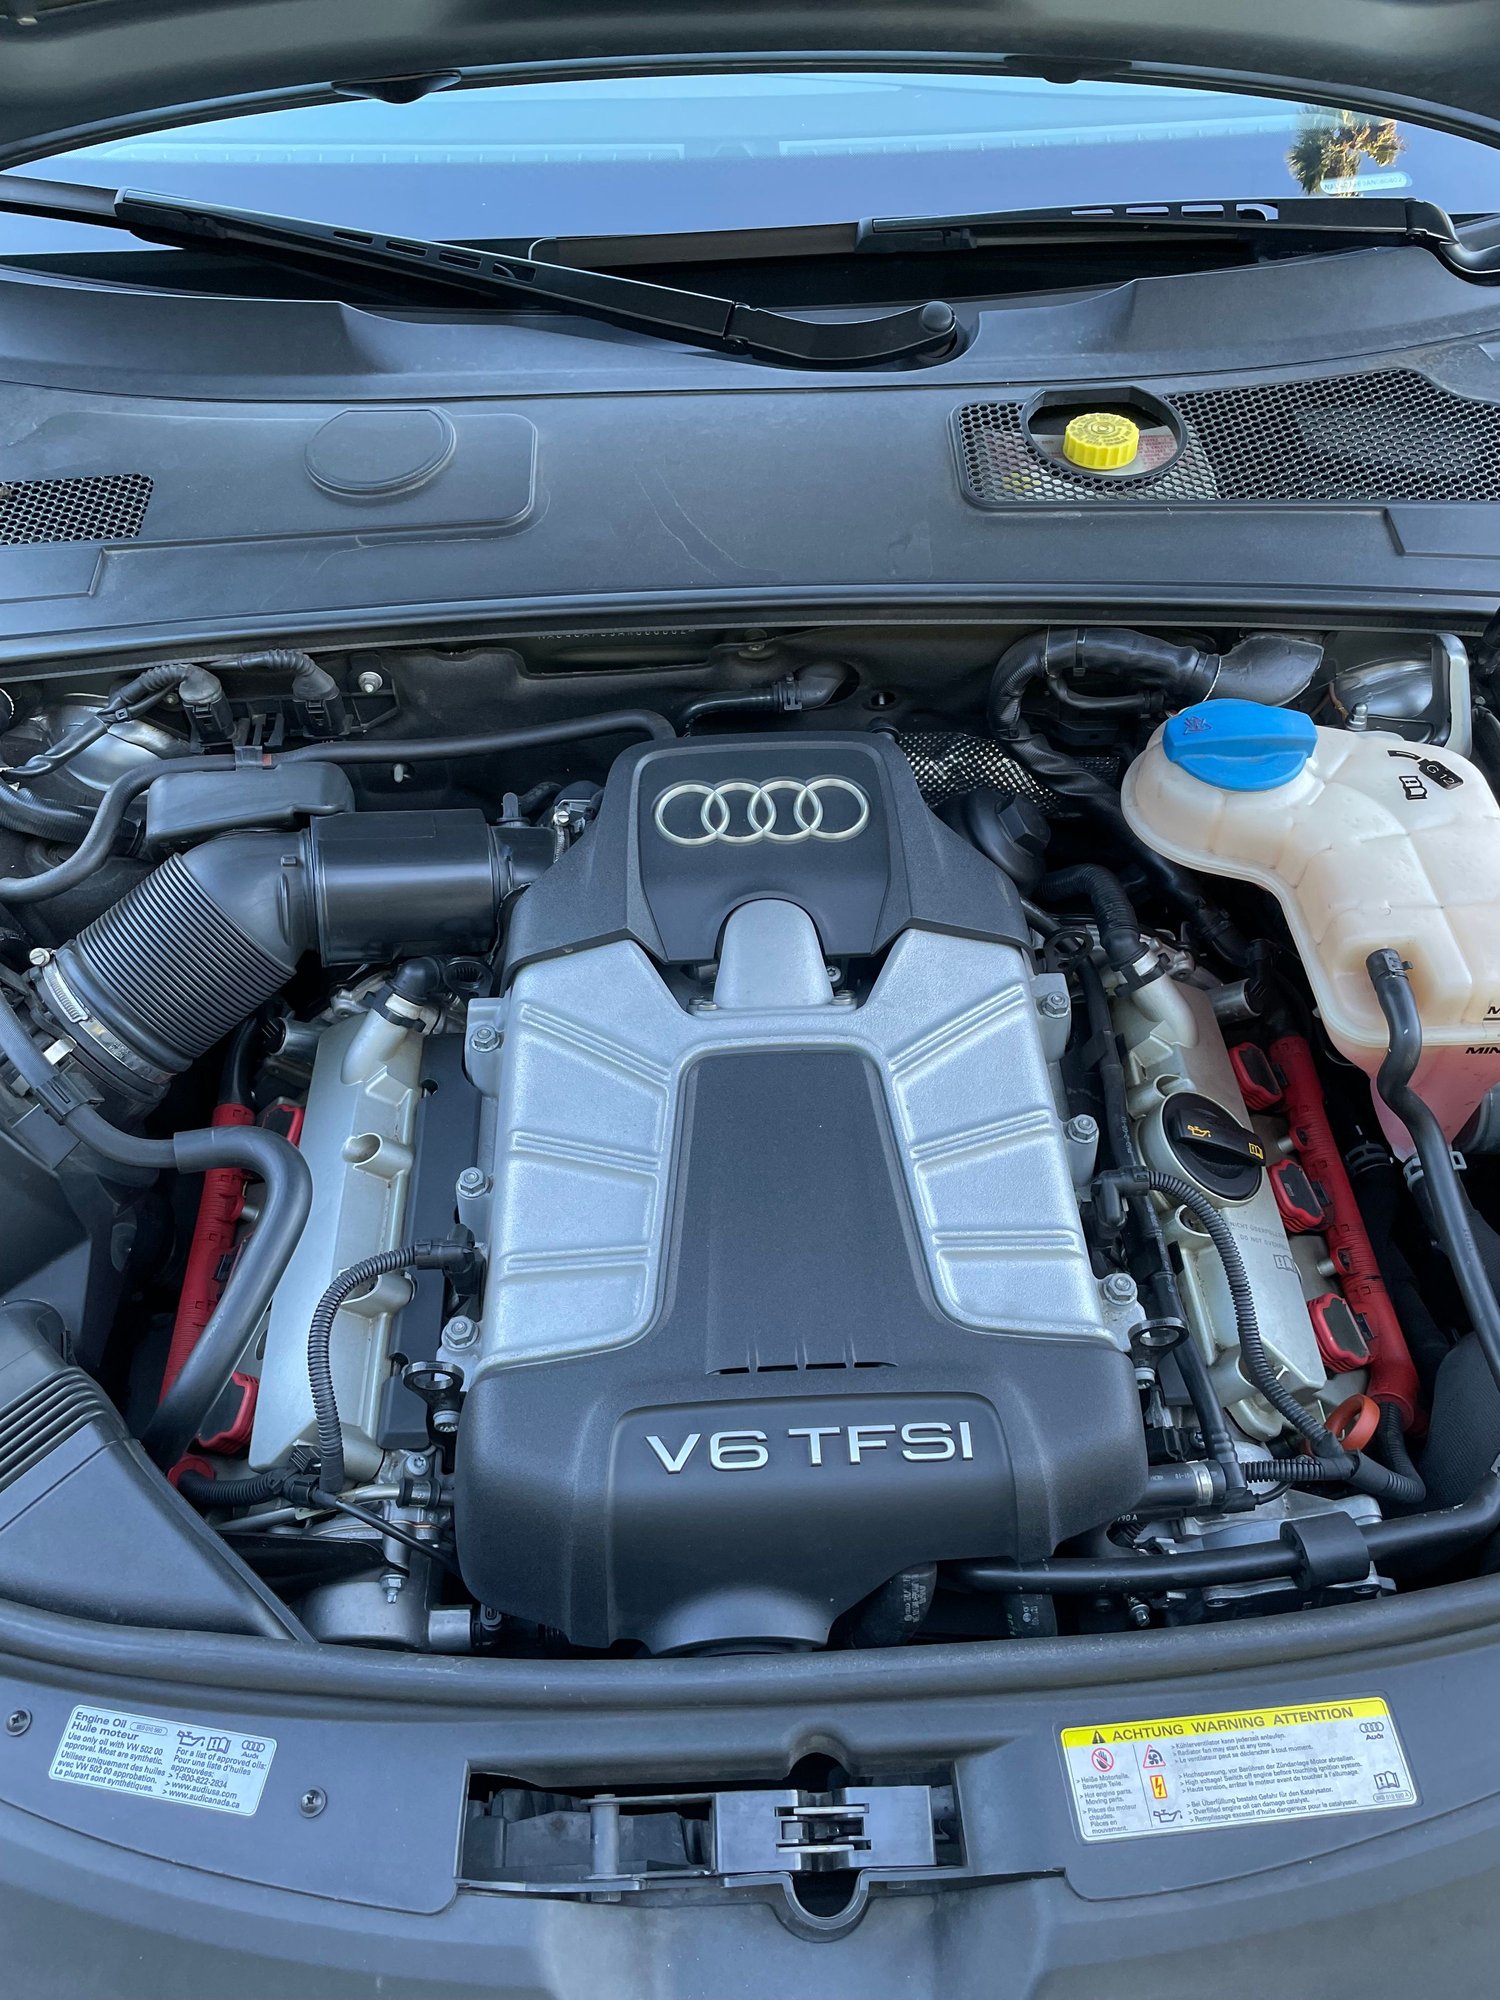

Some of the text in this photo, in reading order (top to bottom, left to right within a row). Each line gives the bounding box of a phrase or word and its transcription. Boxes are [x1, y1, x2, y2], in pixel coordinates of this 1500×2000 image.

[1426, 764, 1455, 785] G 12
[645, 1421, 974, 1474] V6 TFSI
[71, 1721, 139, 1740] Huile moteur
[75, 1712, 127, 1728] Engine Oil
[1113, 1707, 1353, 1741] ACHTUNG WARNING ATTENTION
[65, 1742, 96, 1752] approval.
[98, 1747, 116, 1756] Most
[130, 1754, 162, 1765] synthetic.
[68, 1732, 163, 1756] Use only oil with VW 502 00
[61, 1750, 165, 1776] Utilisez uniquement des huiles
[174, 1755, 190, 1764] Pour
[207, 1761, 221, 1770] liste
[223, 1764, 251, 1775] d'huiles
[176, 1747, 188, 1755] For
[196, 1750, 207, 1759] list
[217, 1756, 251, 1767] approved
[252, 1761, 267, 1770] oils:
[58, 1760, 156, 1783] avec VW 502 00 approbation.
[64, 1770, 90, 1780] plupart
[90, 1775, 106, 1783] sont
[176, 1773, 227, 1788] 1-800-822-2834
[169, 1790, 240, 1808] www.audicanada.ca
[172, 1782, 237, 1798] www.audiusa.com
